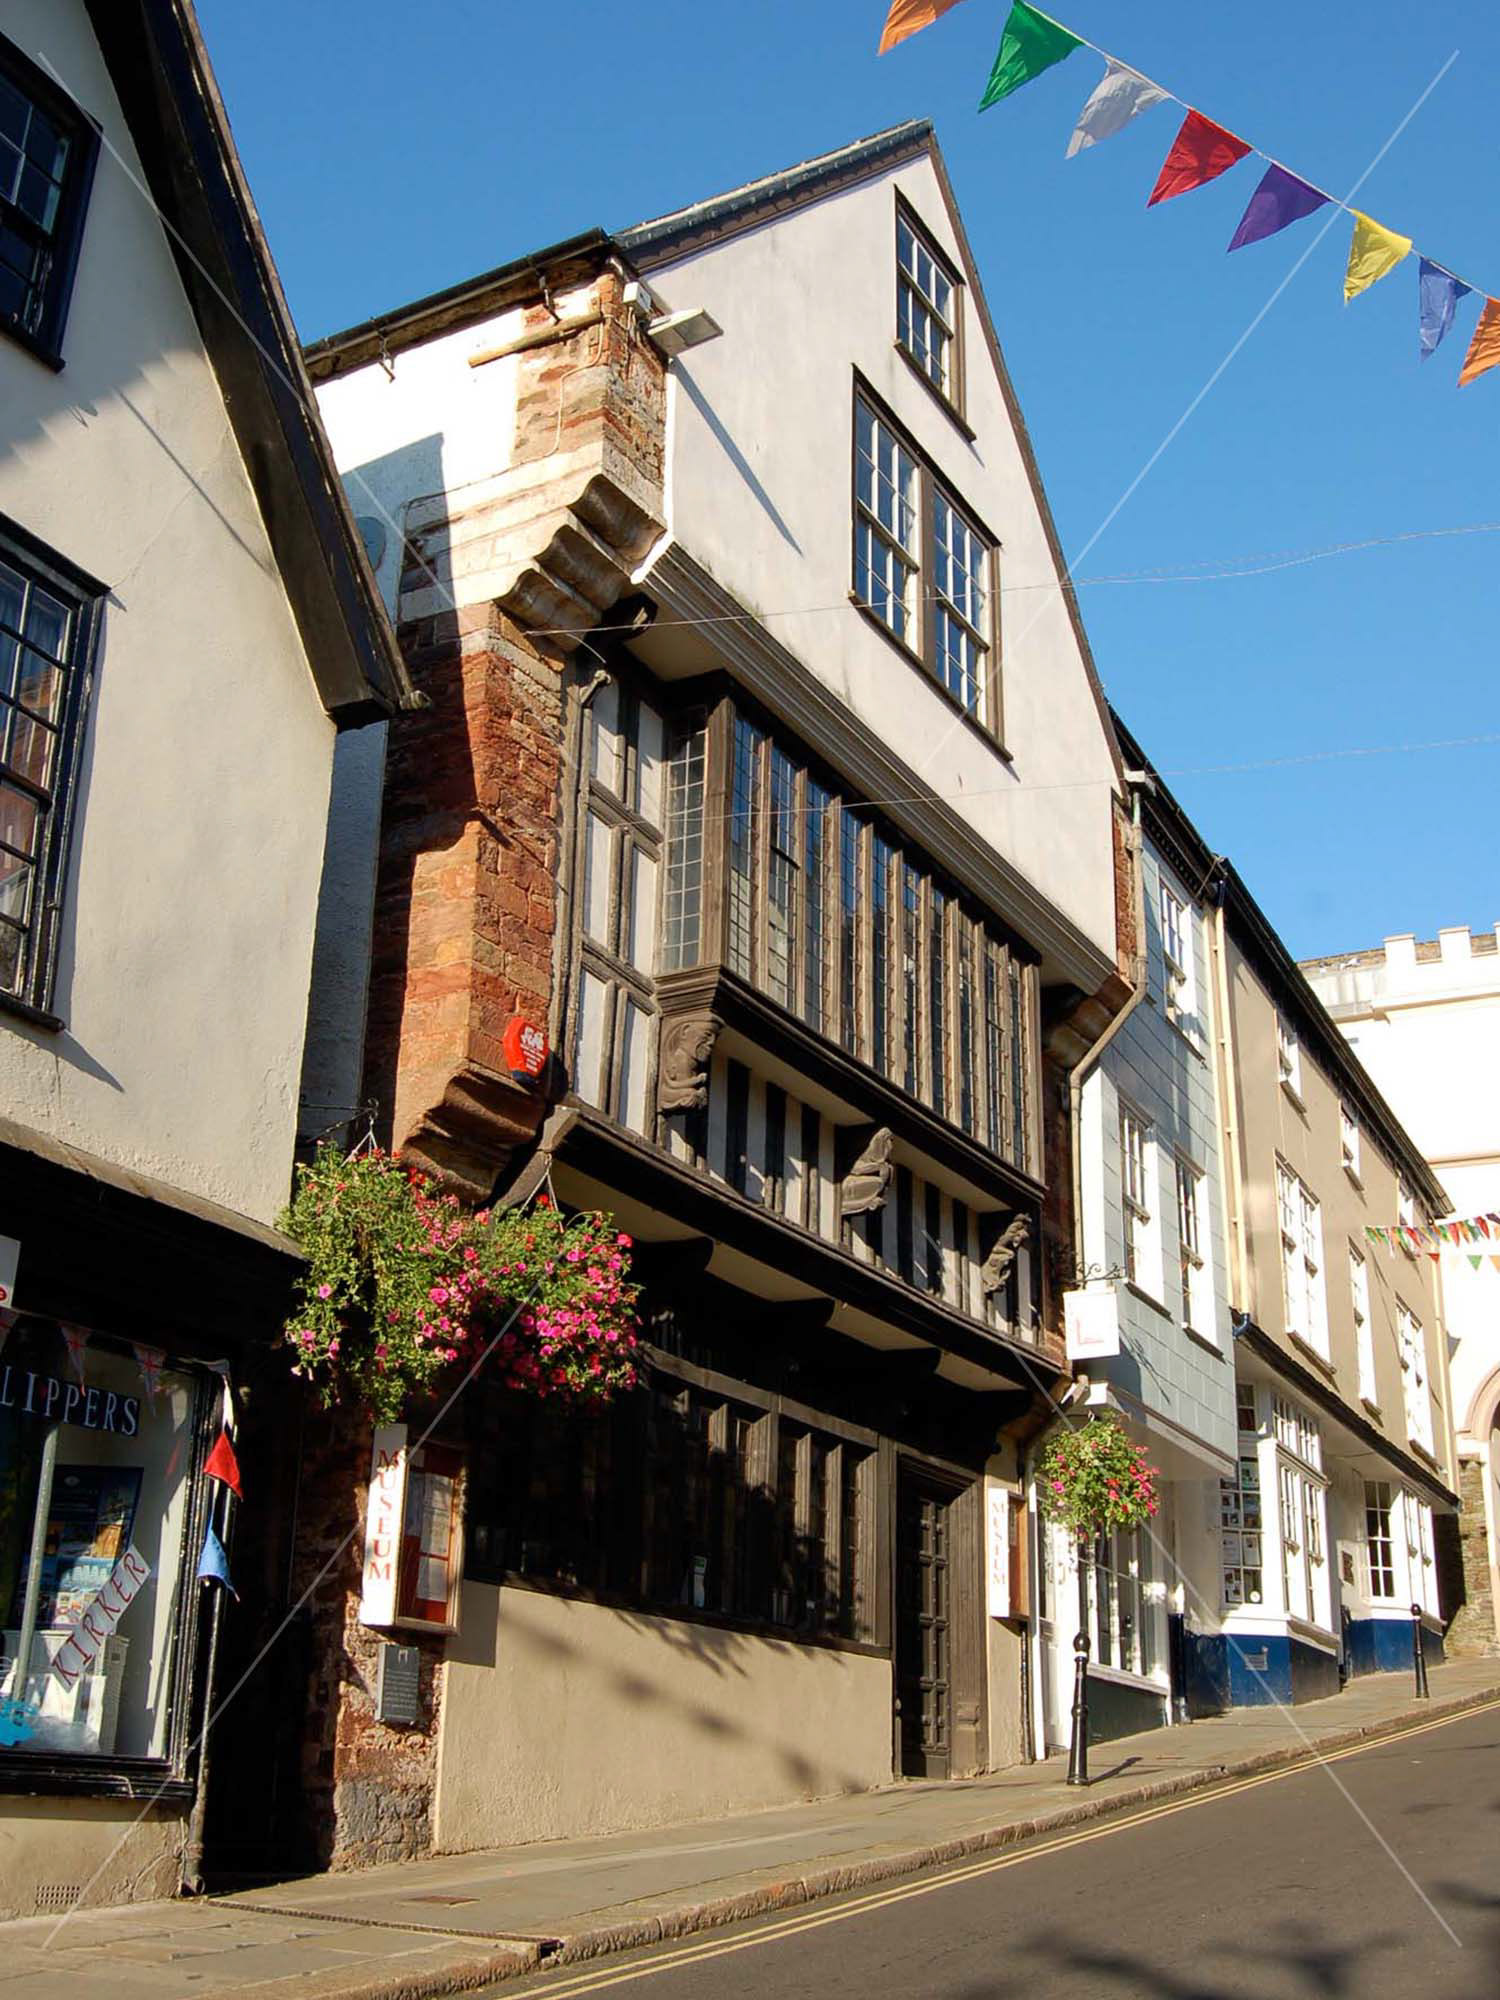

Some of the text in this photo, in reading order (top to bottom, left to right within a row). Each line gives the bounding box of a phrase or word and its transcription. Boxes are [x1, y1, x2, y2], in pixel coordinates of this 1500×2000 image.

[0, 1365, 138, 1435] LIPPERS
[368, 1450, 400, 1581] MUSEUM
[51, 1552, 146, 1686] KIRKER
